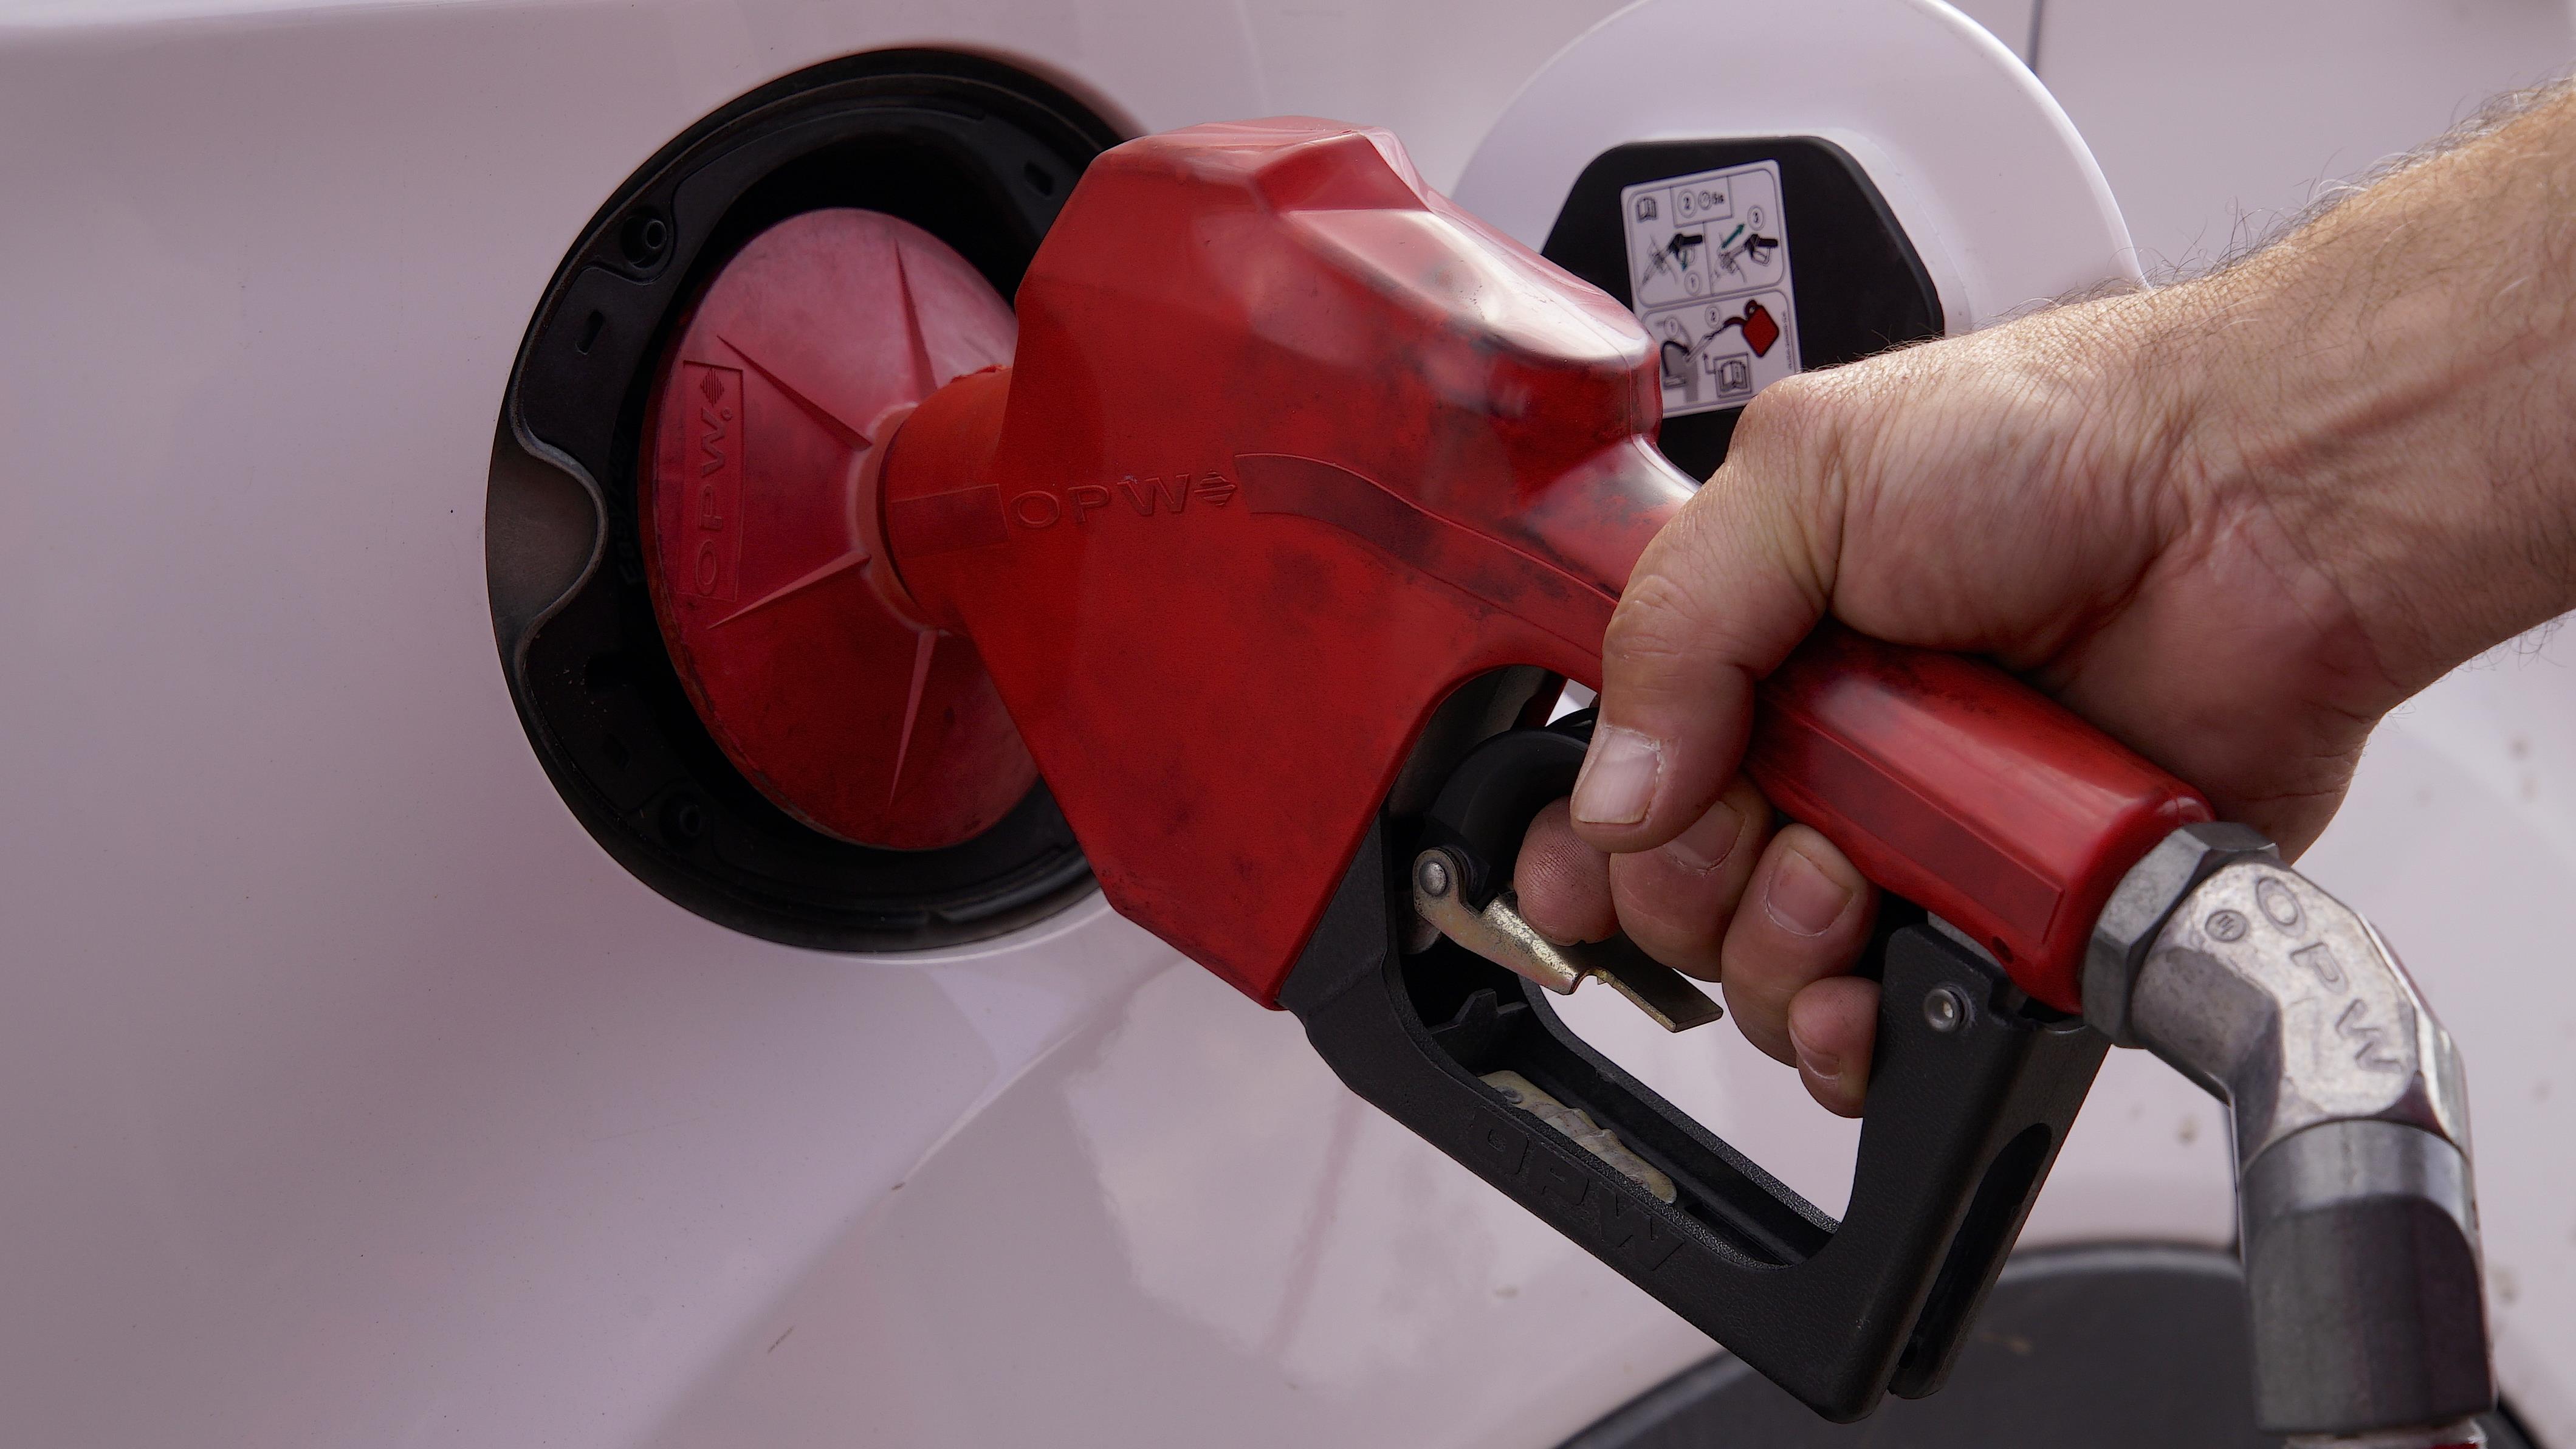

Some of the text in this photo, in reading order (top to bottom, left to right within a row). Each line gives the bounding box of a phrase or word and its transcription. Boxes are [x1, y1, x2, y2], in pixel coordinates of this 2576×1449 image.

[1009, 473, 1190, 528] OPW
[2255, 876, 2405, 1073] OPW
[1468, 1105, 1686, 1272] OPW
